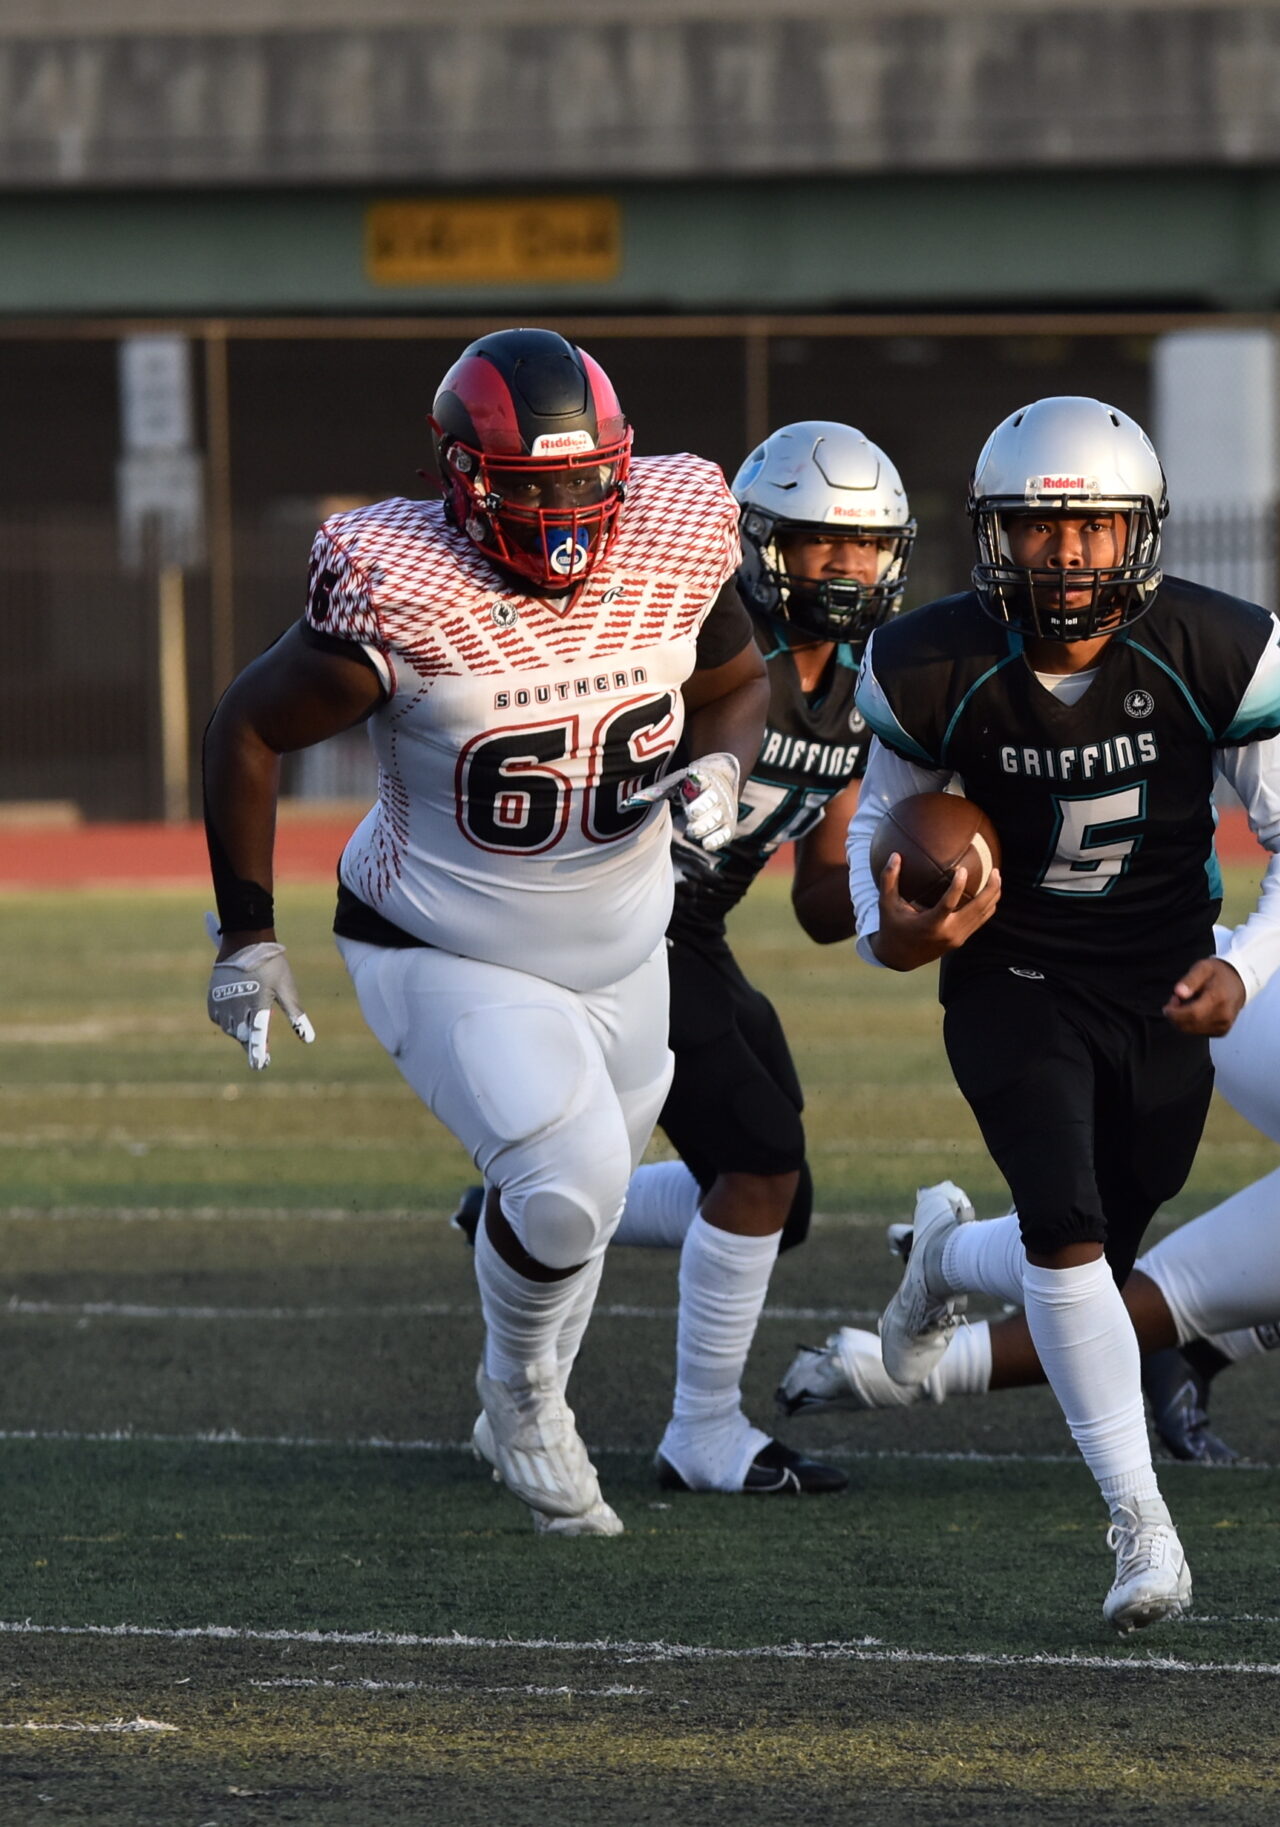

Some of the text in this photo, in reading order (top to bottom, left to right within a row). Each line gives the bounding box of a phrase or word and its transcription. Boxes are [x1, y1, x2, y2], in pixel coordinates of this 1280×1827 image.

[540, 433, 587, 449] Ridd
[1043, 477, 1084, 489] Riddell
[833, 505, 876, 517] Riddll
[494, 667, 648, 710] SOUTHERN
[455, 689, 675, 856] 66
[763, 728, 861, 777] RIFFINS
[1000, 730, 1158, 780] GRIFFINS
[1034, 779, 1148, 897] 5
